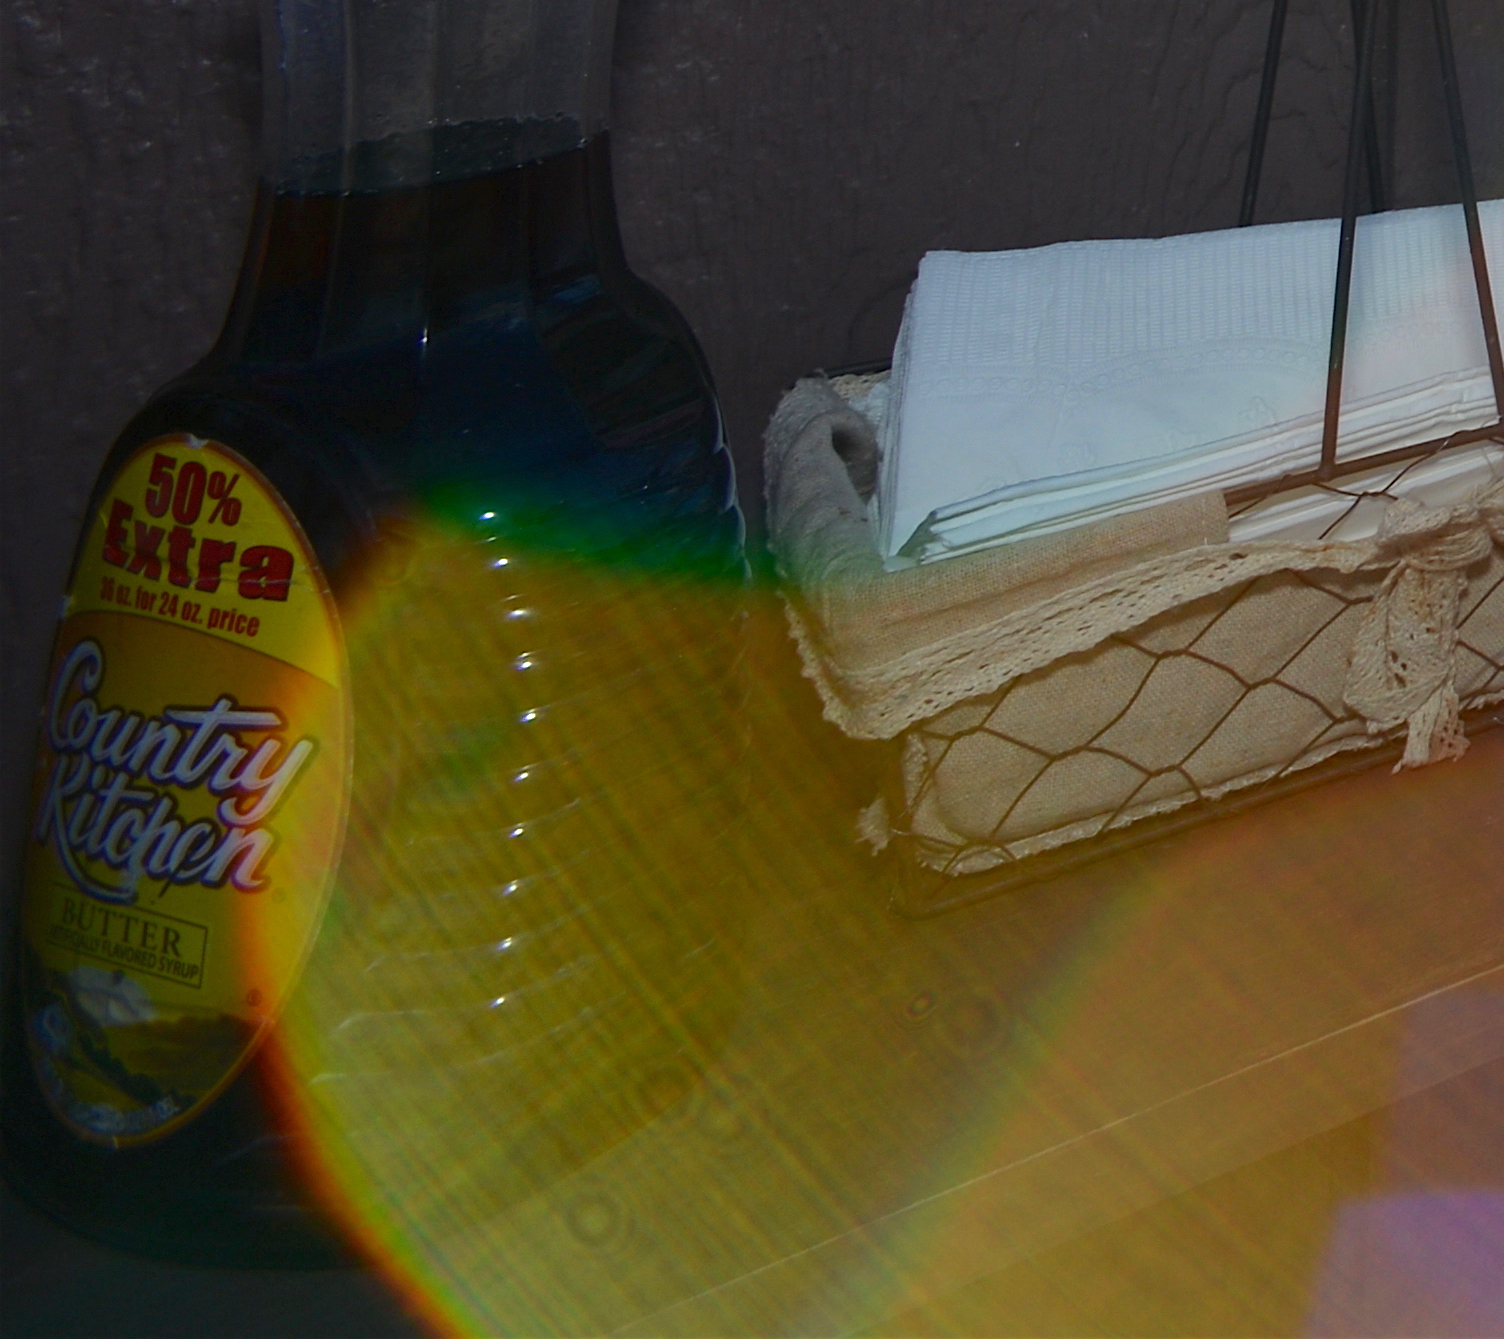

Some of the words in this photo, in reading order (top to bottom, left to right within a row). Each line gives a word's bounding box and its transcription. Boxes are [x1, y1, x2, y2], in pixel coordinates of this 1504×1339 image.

[144, 452, 242, 527] 50%
[102, 497, 295, 603] Extra
[135, 585, 157, 613] for
[158, 591, 179, 618] 24
[181, 600, 203, 625] oz.
[207, 606, 261, 638] price
[50, 640, 314, 825] Country
[35, 754, 275, 902] Kitchen
[61, 896, 182, 958] BUTTER
[101, 941, 157, 968] FLAVORED
[158, 956, 201, 980] SYRUP
